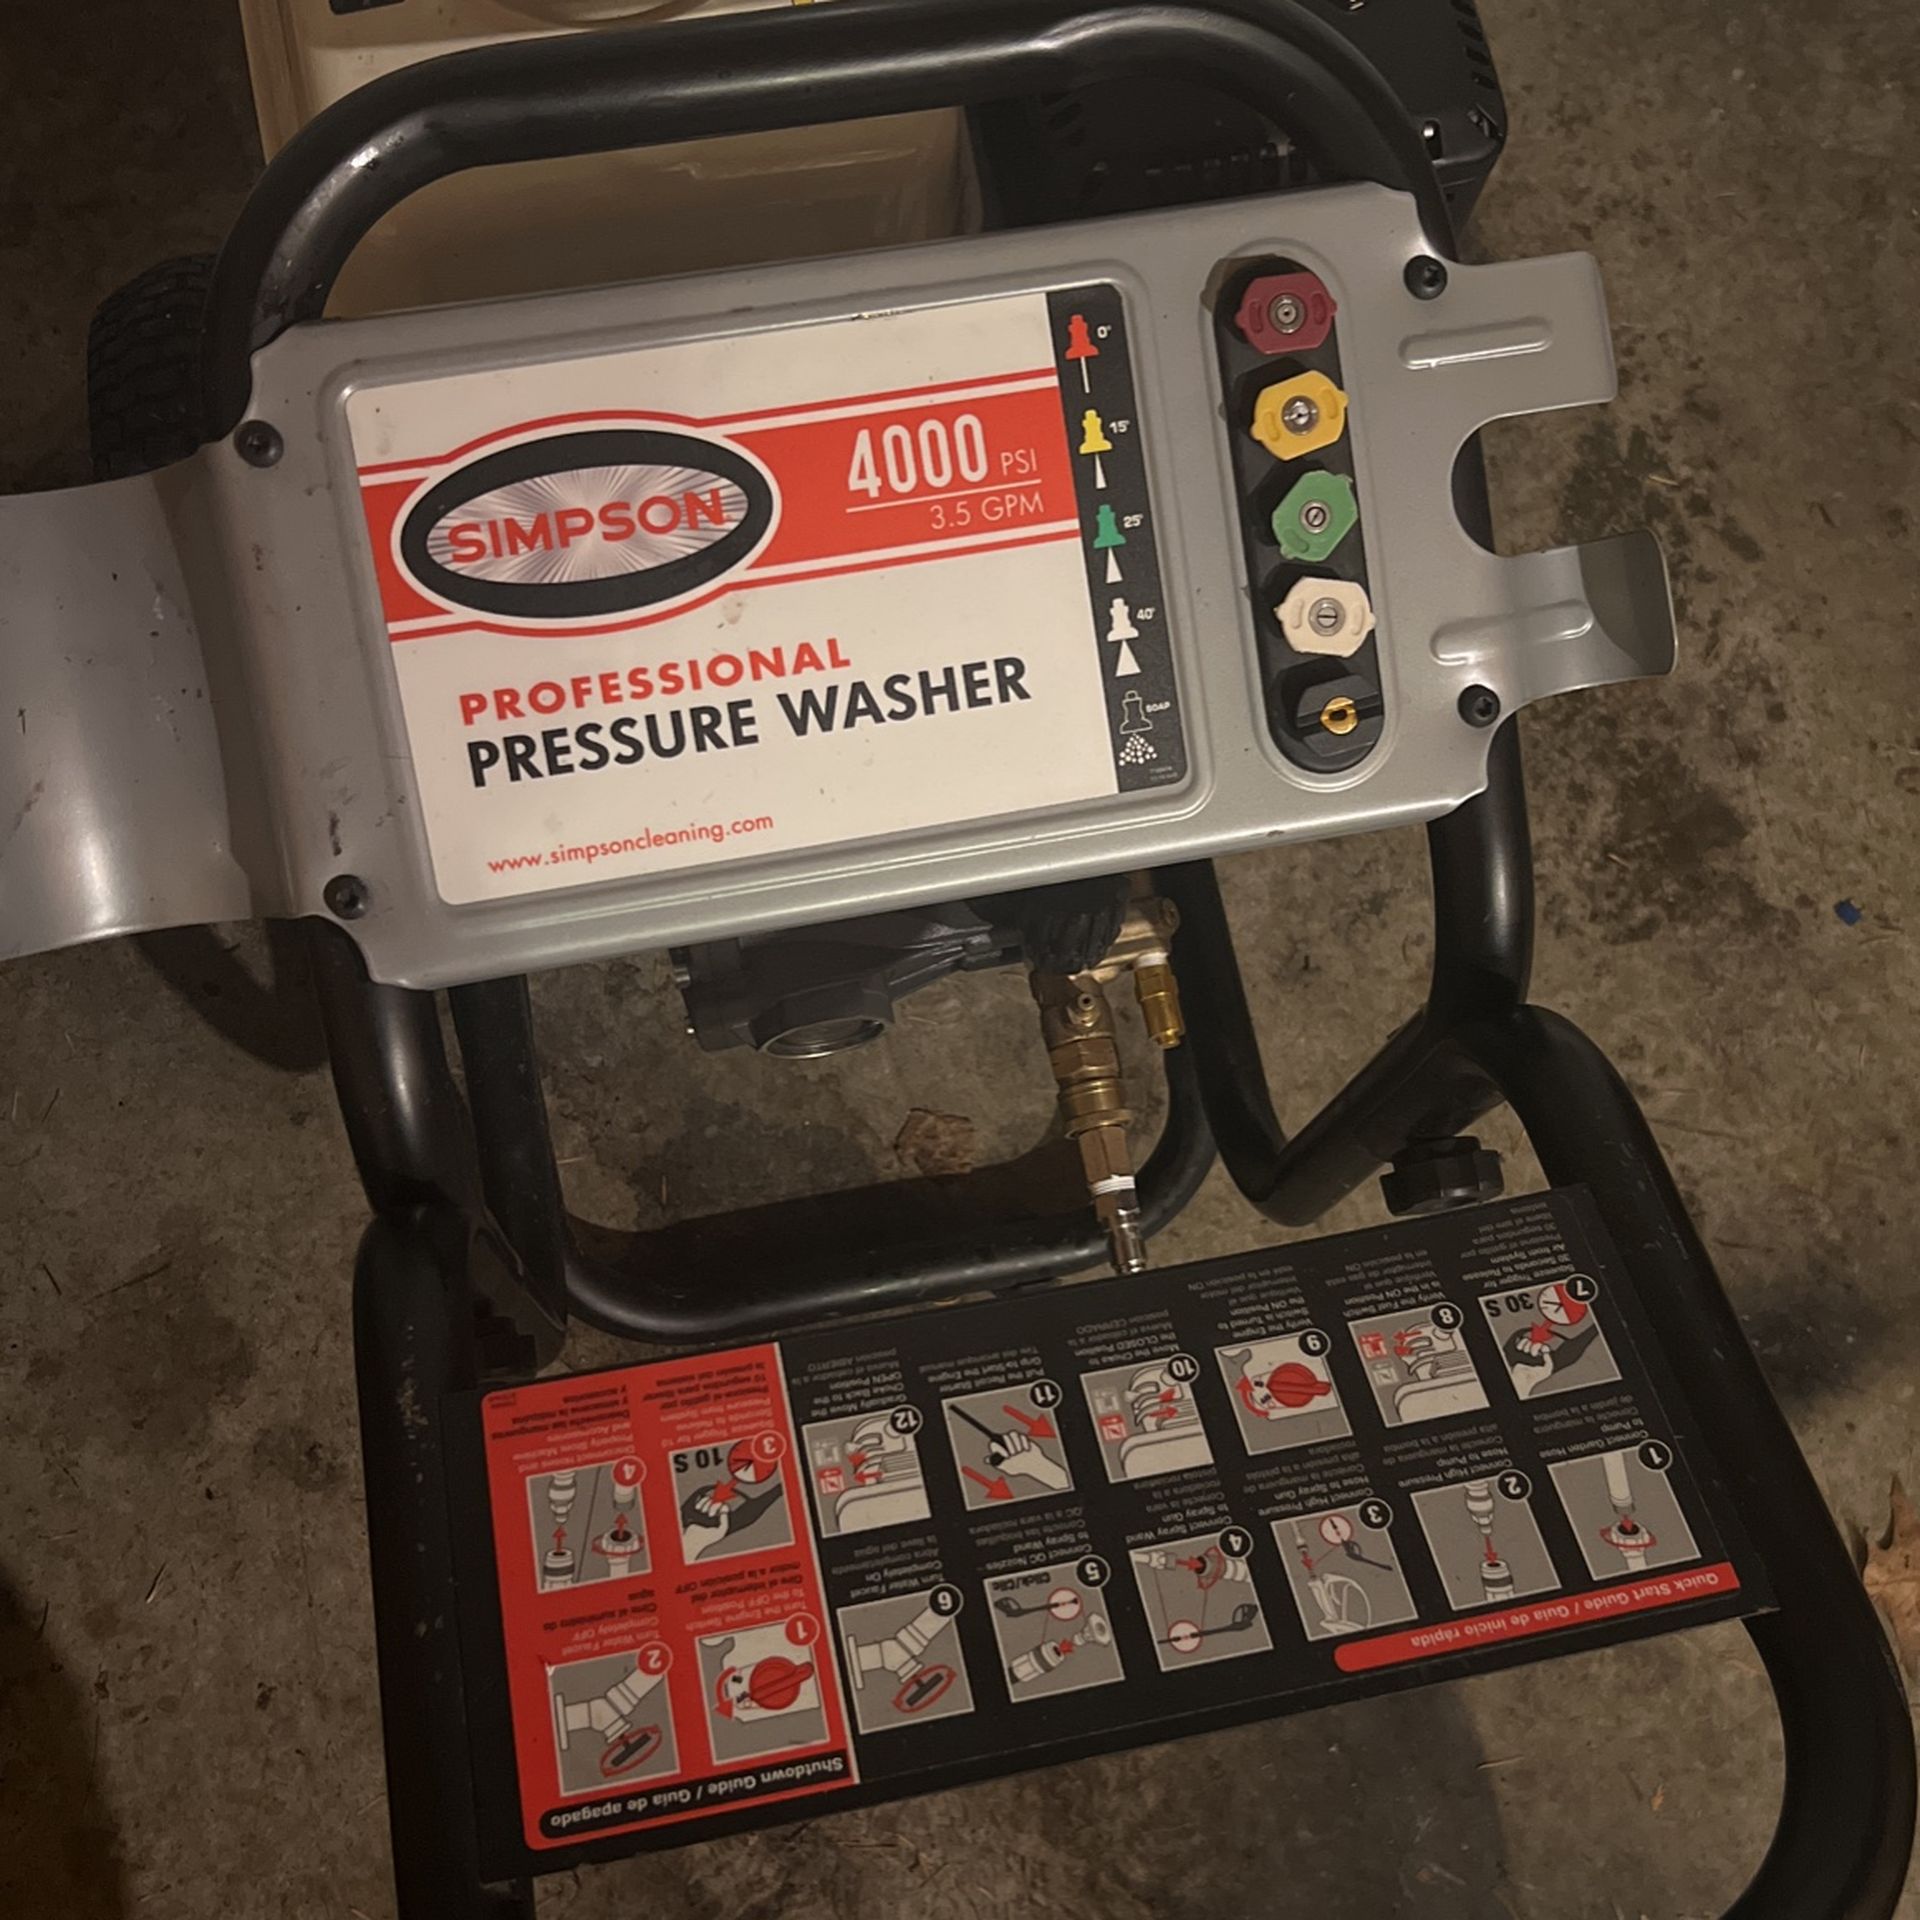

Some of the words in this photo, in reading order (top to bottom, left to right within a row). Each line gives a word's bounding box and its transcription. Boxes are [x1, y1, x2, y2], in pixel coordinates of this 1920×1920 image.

[1109, 420, 1130, 434] 15°
[848, 414, 989, 498] 4000
[1000, 448, 1038, 476] PSI
[930, 501, 971, 530] 3.5
[981, 491, 1045, 521] GPM
[1123, 513, 1144, 528] 25°
[448, 487, 727, 563] SIMPSON
[459, 637, 852, 725] PROFESSIONAL
[466, 698, 760, 788] PRESSURE
[776, 656, 1032, 737] WASHER
[488, 814, 774, 875] www.simpsoncleaning.com
[1569, 1278, 1590, 1296] 7
[1482, 1299, 1502, 1317] S
[1503, 1291, 1536, 1313] 30
[1437, 1306, 1455, 1323] 8
[1303, 1333, 1321, 1351] 9
[1169, 1357, 1196, 1378] 10
[1033, 1383, 1057, 1403] 11
[892, 1408, 918, 1429] 12
[760, 1434, 776, 1454] 3
[672, 1452, 689, 1474] S
[692, 1445, 724, 1470] 10
[1646, 1445, 1664, 1464] 1
[621, 1461, 637, 1481] 4
[1503, 1475, 1522, 1494] 2
[1365, 1504, 1383, 1523] 3
[1226, 1532, 1244, 1551] 4
[1082, 1560, 1101, 1580] 5
[991, 1572, 1050, 1593] Click/Clic
[1630, 1582, 1672, 1601] Start
[1672, 1571, 1720, 1592] Quick
[936, 1590, 954, 1610] 6
[1581, 1591, 1630, 1611] Guide
[794, 1619, 809, 1639] 1
[1463, 1618, 1507, 1638] inicio
[1508, 1612, 1531, 1627] de
[1408, 1625, 1461, 1649] rápida
[646, 1648, 662, 1669] 2
[759, 1755, 844, 1786] Shutdown
[706, 1774, 756, 1797] Guide
[549, 1799, 622, 1829] apagado
[626, 1796, 648, 1813] de
